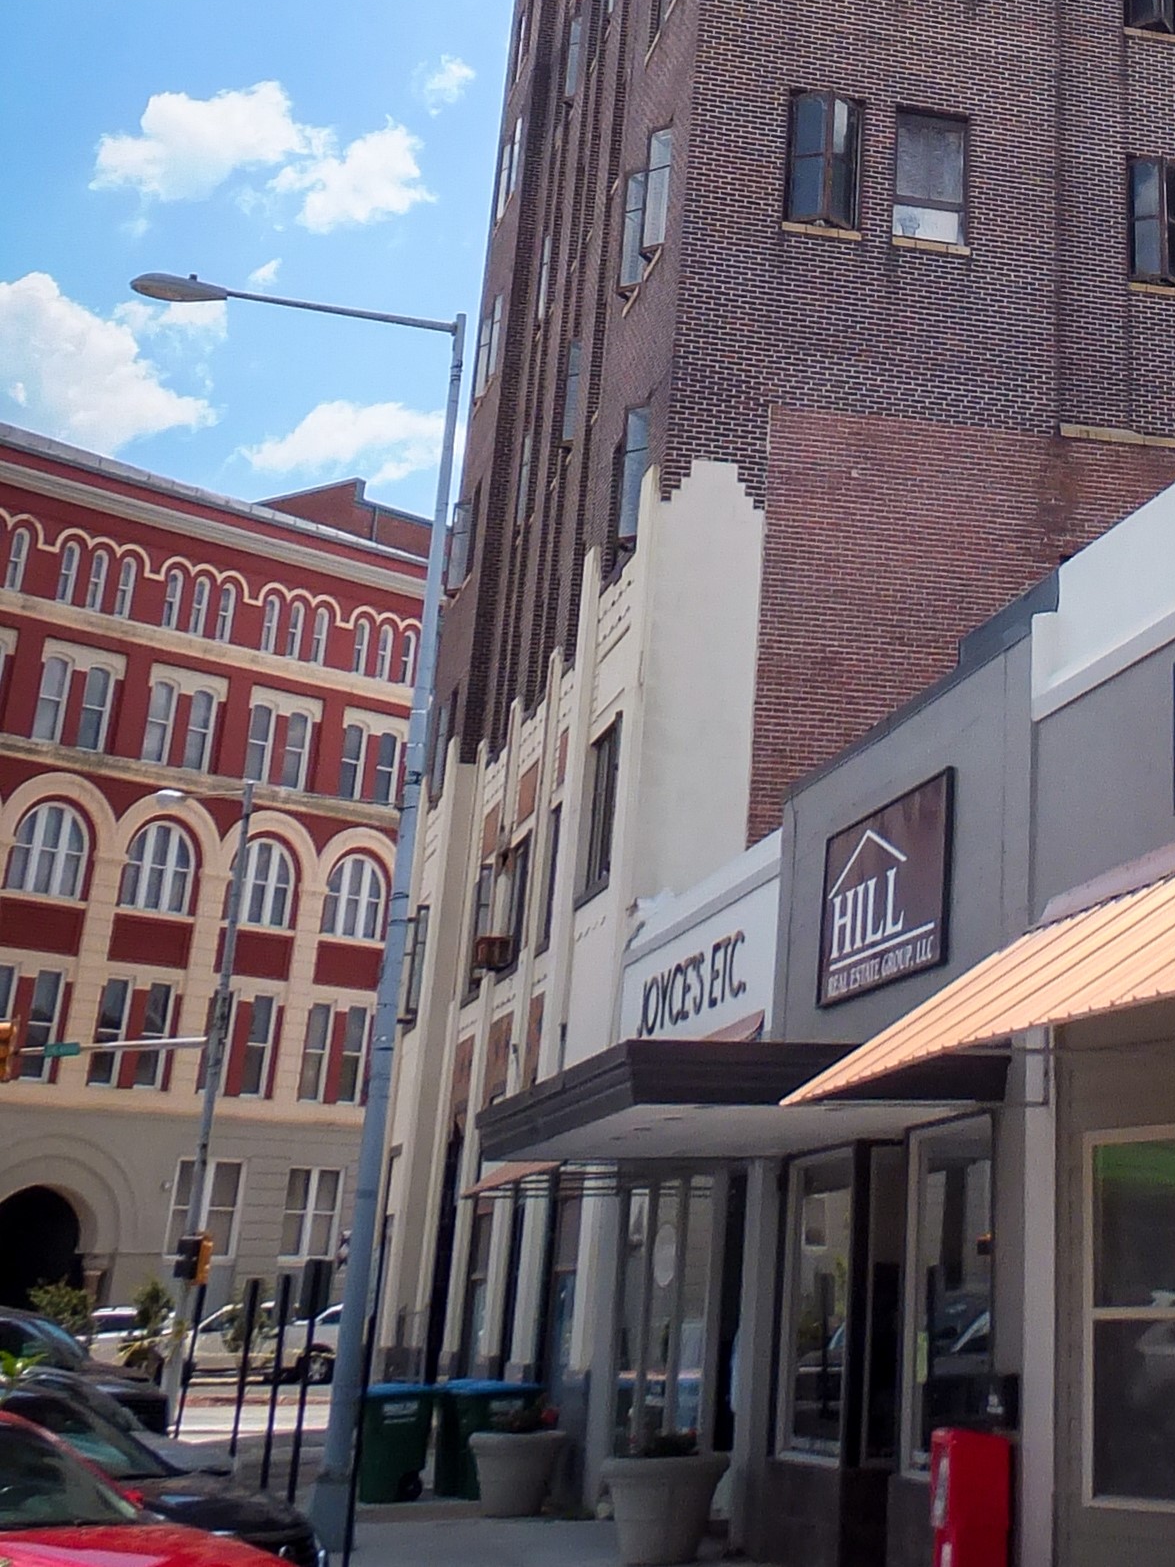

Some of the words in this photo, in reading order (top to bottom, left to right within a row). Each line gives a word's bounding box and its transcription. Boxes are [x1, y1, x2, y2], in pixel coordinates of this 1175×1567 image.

[830, 867, 904, 960] HILL
[827, 971, 848, 998] REAL
[849, 957, 881, 989] ESTATE
[915, 935, 934, 964] LLC
